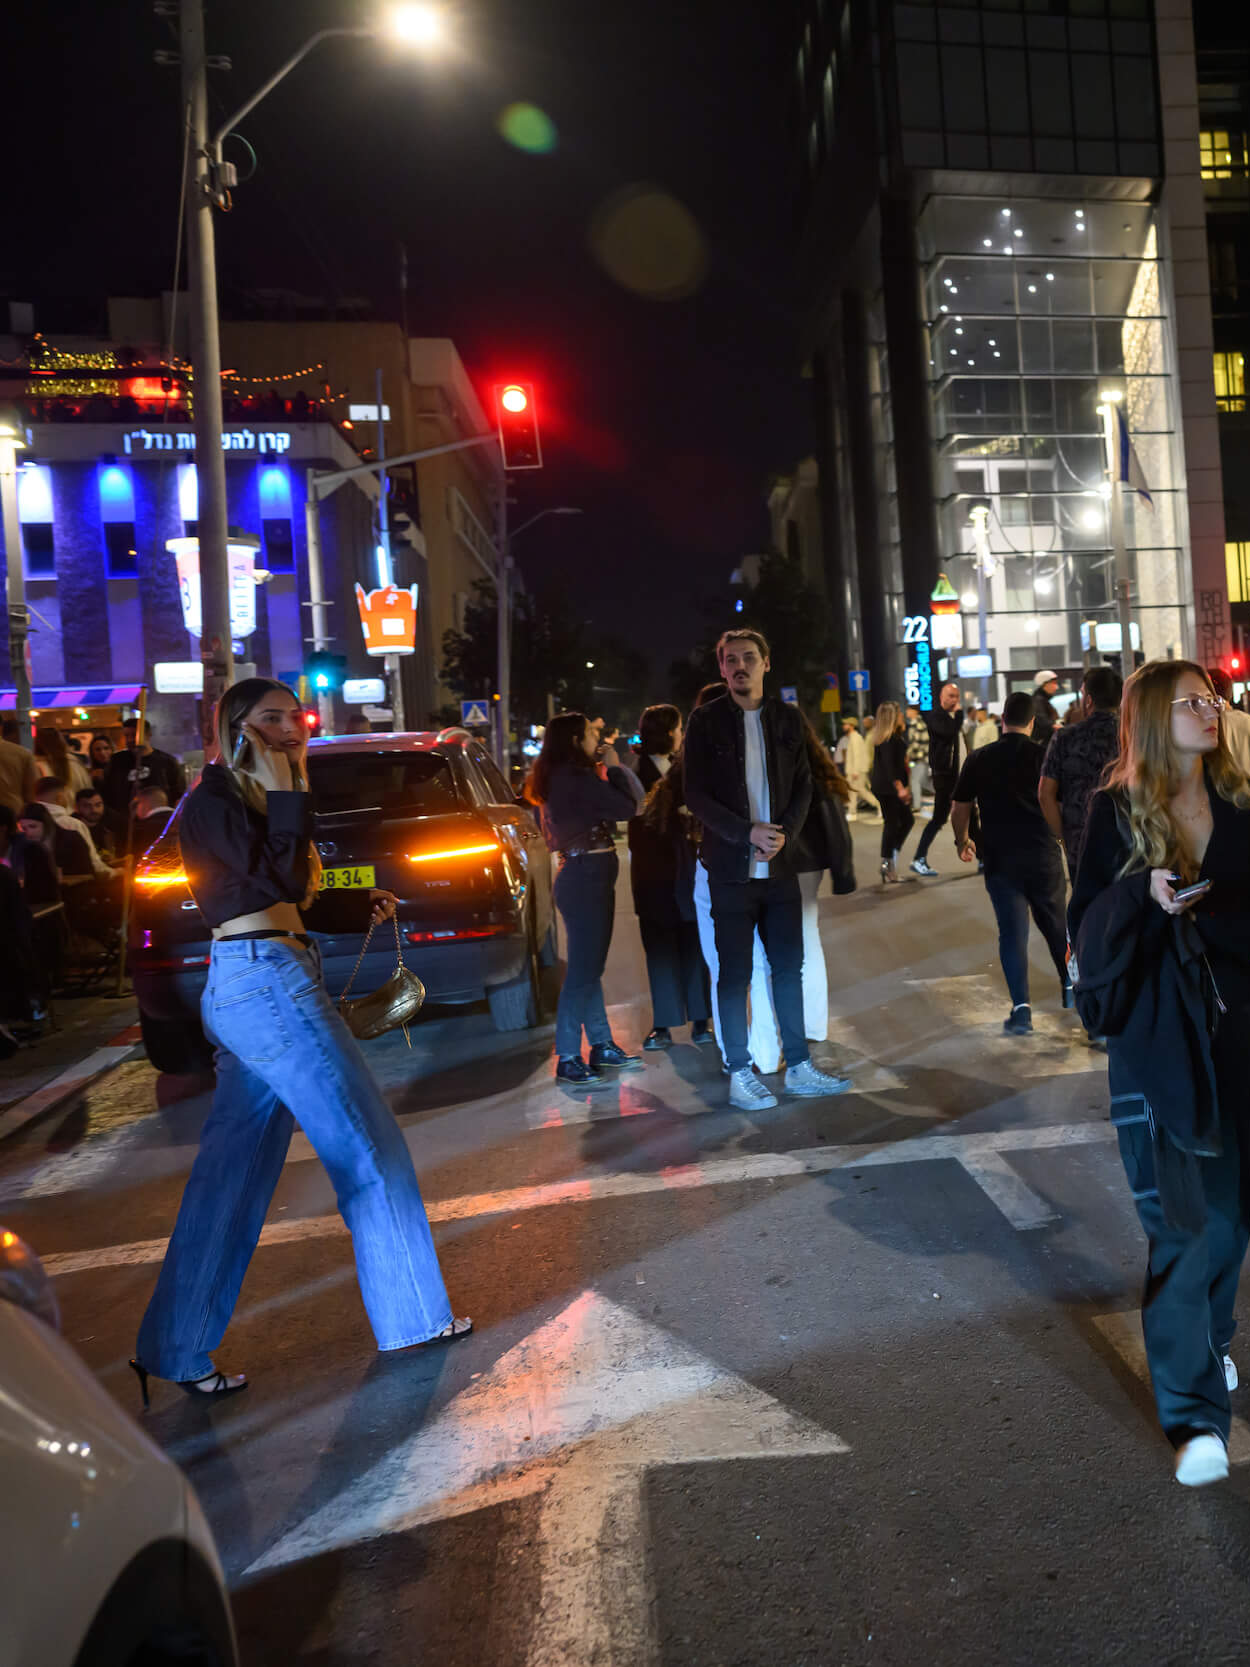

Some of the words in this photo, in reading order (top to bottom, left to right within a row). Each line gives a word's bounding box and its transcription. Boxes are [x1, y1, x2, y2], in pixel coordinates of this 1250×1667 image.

[176, 428, 255, 450] להשות
[258, 432, 290, 454] קרן
[902, 616, 929, 643] 22
[915, 641, 933, 711] ROTHSCHILD
